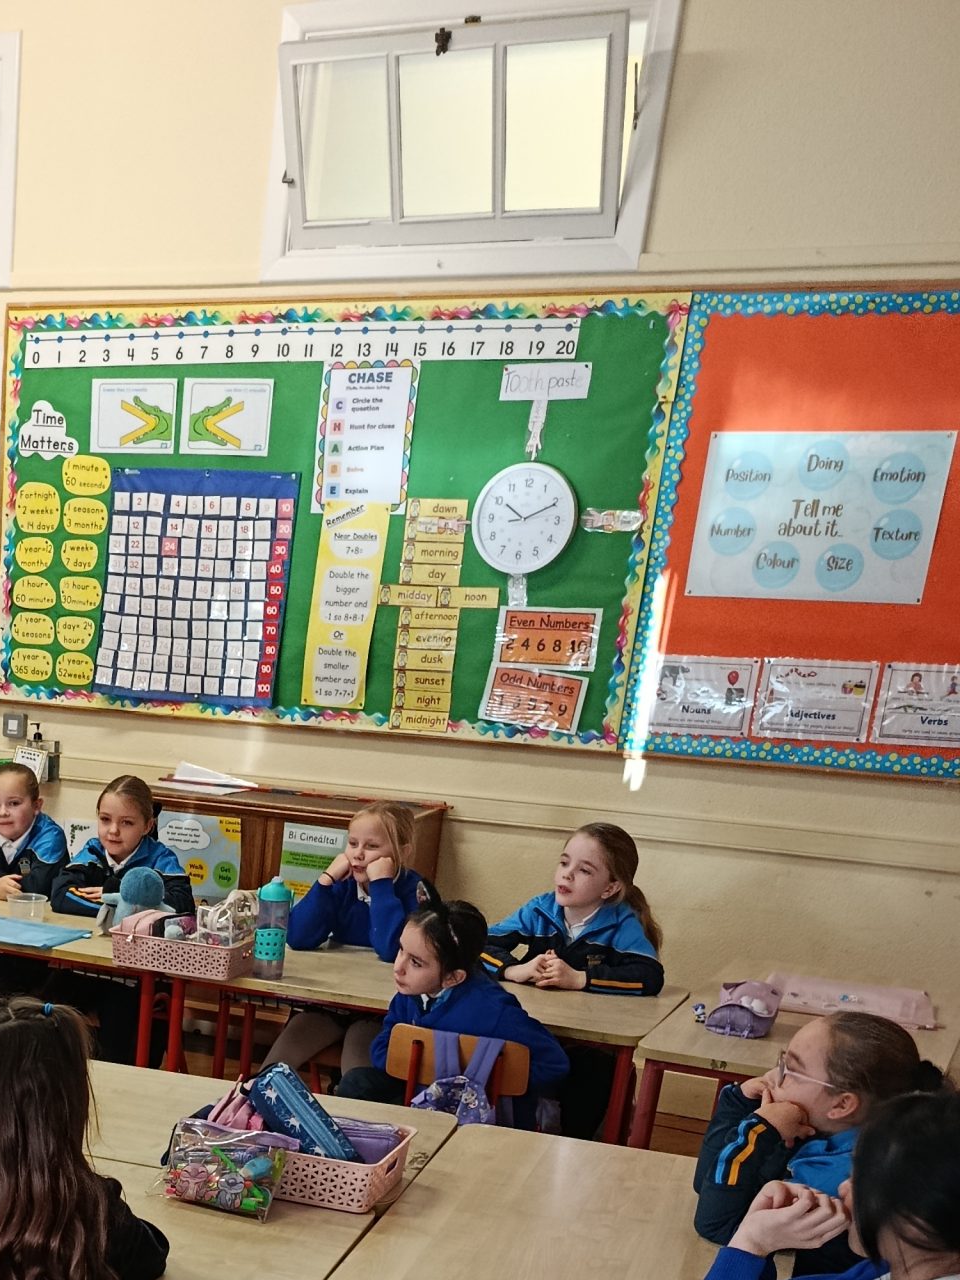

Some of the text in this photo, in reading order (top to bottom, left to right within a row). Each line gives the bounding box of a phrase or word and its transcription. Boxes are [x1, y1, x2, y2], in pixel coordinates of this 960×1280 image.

[32, 351, 40, 364] 0
[78, 350, 87, 363] 2
[102, 349, 110, 362] 3
[127, 348, 135, 362] 4
[150, 348, 160, 361] 5
[175, 346, 184, 360] 6
[200, 346, 208, 359] 7
[225, 345, 234, 358] 8
[250, 344, 260, 358] 9
[276, 343, 290, 357] 10
[304, 344, 314, 358] 11
[330, 343, 344, 358] 12
[357, 342, 371, 357] 13
[385, 342, 398, 356] 14
[413, 342, 428, 356] 15
[441, 341, 456, 356] 16
[470, 341, 485, 356] 17
[499, 340, 514, 356] 18
[528, 340, 545, 356] 19
[556, 340, 576, 355] 20
[348, 372, 393, 384] CHASE
[32, 409, 64, 426] Time
[20, 434, 74, 451] Matters
[72, 463, 100, 472] minute
[807, 454, 844, 472] Doing
[725, 466, 926, 484] Position Emotion
[65, 476, 106, 490] 60 seconds
[508, 483, 516, 493] 11
[524, 478, 534, 488] 12
[19, 490, 57, 502] Fortnight
[495, 496, 504, 506] 10
[552, 496, 559, 506] 2
[30, 506, 54, 515] weeks
[282, 503, 291, 512] 10
[432, 504, 458, 514] dawn
[792, 498, 844, 520] Tell me
[325, 504, 366, 527] Remember
[488, 513, 495, 524] 9
[554, 515, 561, 526] 3
[36, 522, 56, 532] days
[74, 521, 104, 530] months
[279, 524, 290, 534] 20
[710, 523, 754, 538] Number
[778, 518, 822, 538] about
[334, 532, 378, 541] Near Doubles
[489, 531, 496, 542] 8
[546, 534, 554, 544] 4
[873, 526, 921, 542] Texture
[274, 545, 286, 555] 30
[420, 548, 460, 560] morning
[500, 545, 506, 555] 7
[532, 546, 539, 557] 5
[515, 550, 522, 561] 6
[20, 560, 49, 568] months
[73, 558, 92, 568] days
[756, 552, 800, 570] Colour
[826, 556, 854, 572] Size
[270, 564, 282, 574] 40
[329, 570, 370, 580] Double the
[428, 570, 447, 581] day
[72, 582, 90, 590] hour
[270, 586, 282, 595] 50
[336, 585, 360, 598] bigger
[398, 591, 433, 602] midday
[15, 594, 54, 604] 60 minutes
[464, 593, 488, 602] noon
[325, 600, 368, 608] number and
[266, 606, 277, 615] 60
[334, 614, 342, 622] so
[414, 611, 458, 621] afternoon
[83, 621, 94, 630] 24
[509, 616, 590, 630] Even Numbers
[22, 631, 52, 639] seasons
[265, 626, 276, 635] 70
[333, 630, 344, 639] Or
[63, 636, 86, 644] hours
[416, 635, 452, 647] evening
[506, 638, 562, 652] 2 4 6 8
[265, 646, 276, 655] 80
[318, 648, 357, 658] Double the
[22, 653, 40, 662] year
[420, 654, 444, 664] dusk
[260, 664, 272, 674] 90
[323, 661, 350, 670] smaller
[14, 665, 49, 677] 365 days
[315, 675, 356, 685] number and
[414, 676, 446, 686] sunset
[500, 672, 575, 695] Odd Numbers
[257, 683, 270, 693] 100
[416, 694, 442, 707] night
[558, 703, 568, 717] 9
[681, 704, 712, 714] Nouns
[405, 714, 446, 728] midnight
[787, 710, 836, 722] Adjectives
[920, 716, 948, 726] Verbs
[300, 832, 338, 846] Cineálta!
[218, 874, 232, 882] Help
